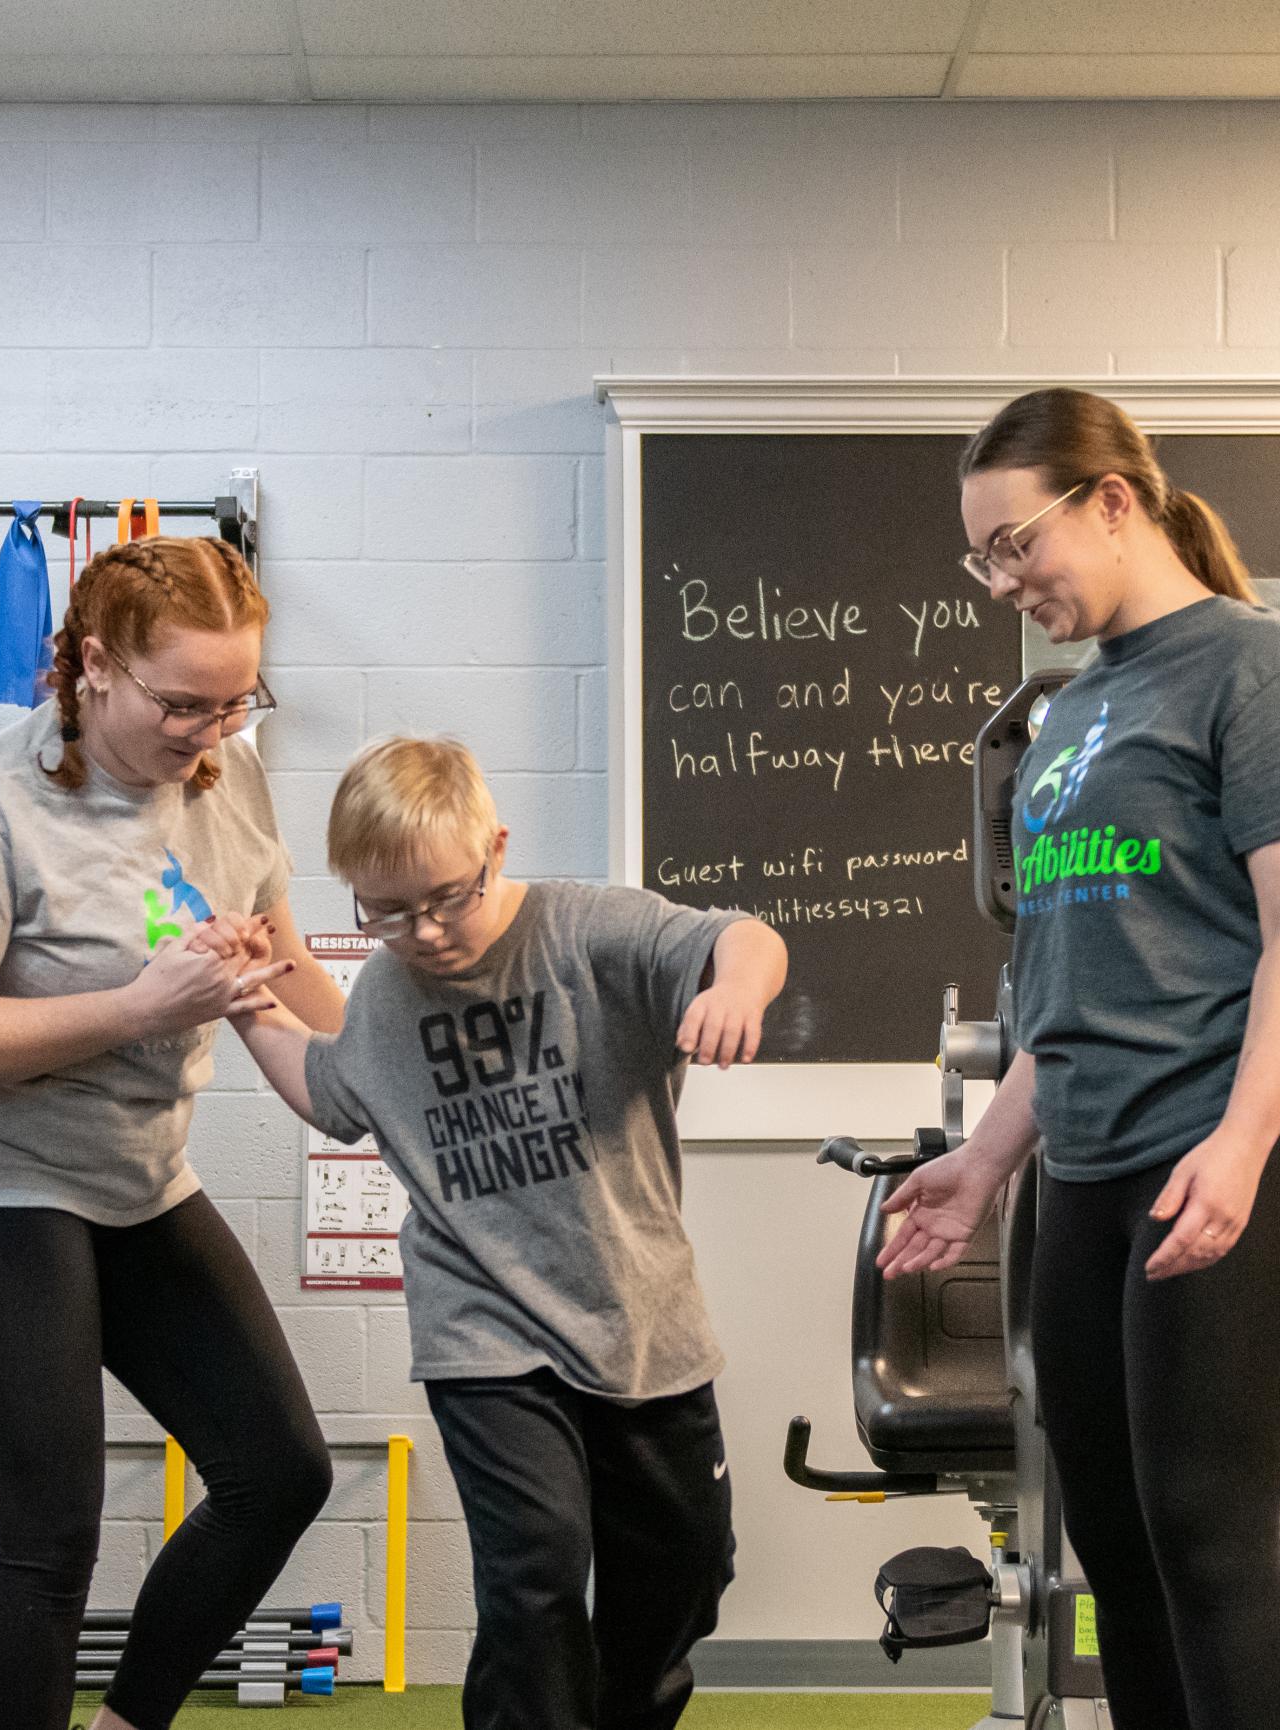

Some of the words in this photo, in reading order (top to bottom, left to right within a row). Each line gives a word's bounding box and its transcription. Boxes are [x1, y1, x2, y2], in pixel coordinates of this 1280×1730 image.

[899, 599, 980, 657] you
[669, 680, 744, 712] can
[776, 667, 851, 709] and
[879, 665, 1004, 725] you're
[671, 731, 846, 791] halfway
[867, 734, 976, 769] there
[657, 855, 745, 886] Guest
[763, 848, 823, 876] wifi
[846, 838, 968, 881] password
[1021, 823, 1163, 895] Abilities
[709, 897, 923, 925] bilities54321
[1058, 884, 1131, 905] ENTER
[310, 936, 384, 950] RESISTAN
[419, 990, 565, 1098] 99%
[424, 1082, 548, 1149] CHANCE
